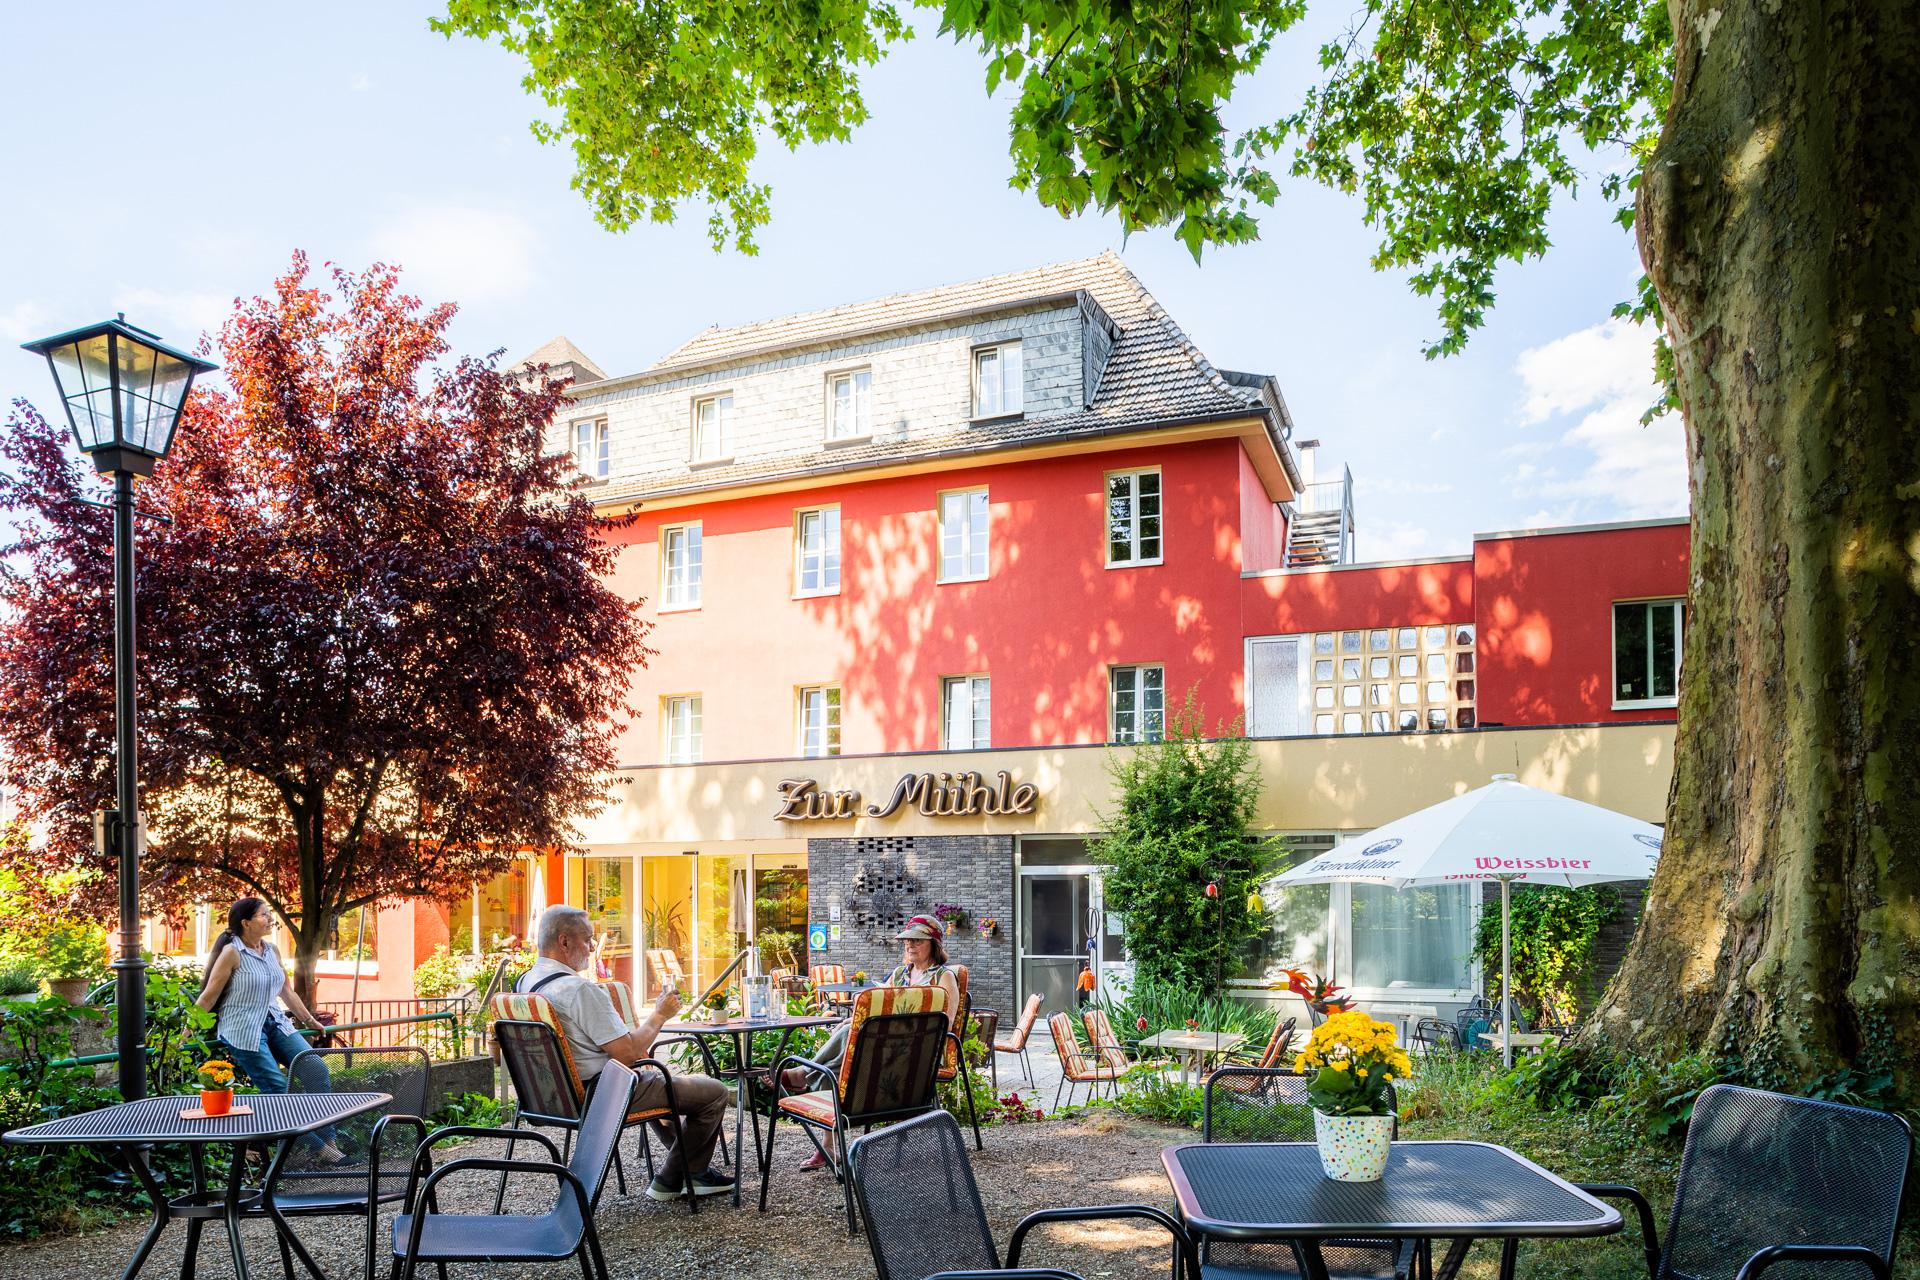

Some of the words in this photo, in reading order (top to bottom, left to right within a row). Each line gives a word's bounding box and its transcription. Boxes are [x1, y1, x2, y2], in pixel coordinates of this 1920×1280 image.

[773, 778, 861, 821] Zur
[866, 770, 1040, 819] Mühle
[1474, 856, 1592, 870] Weissbier
